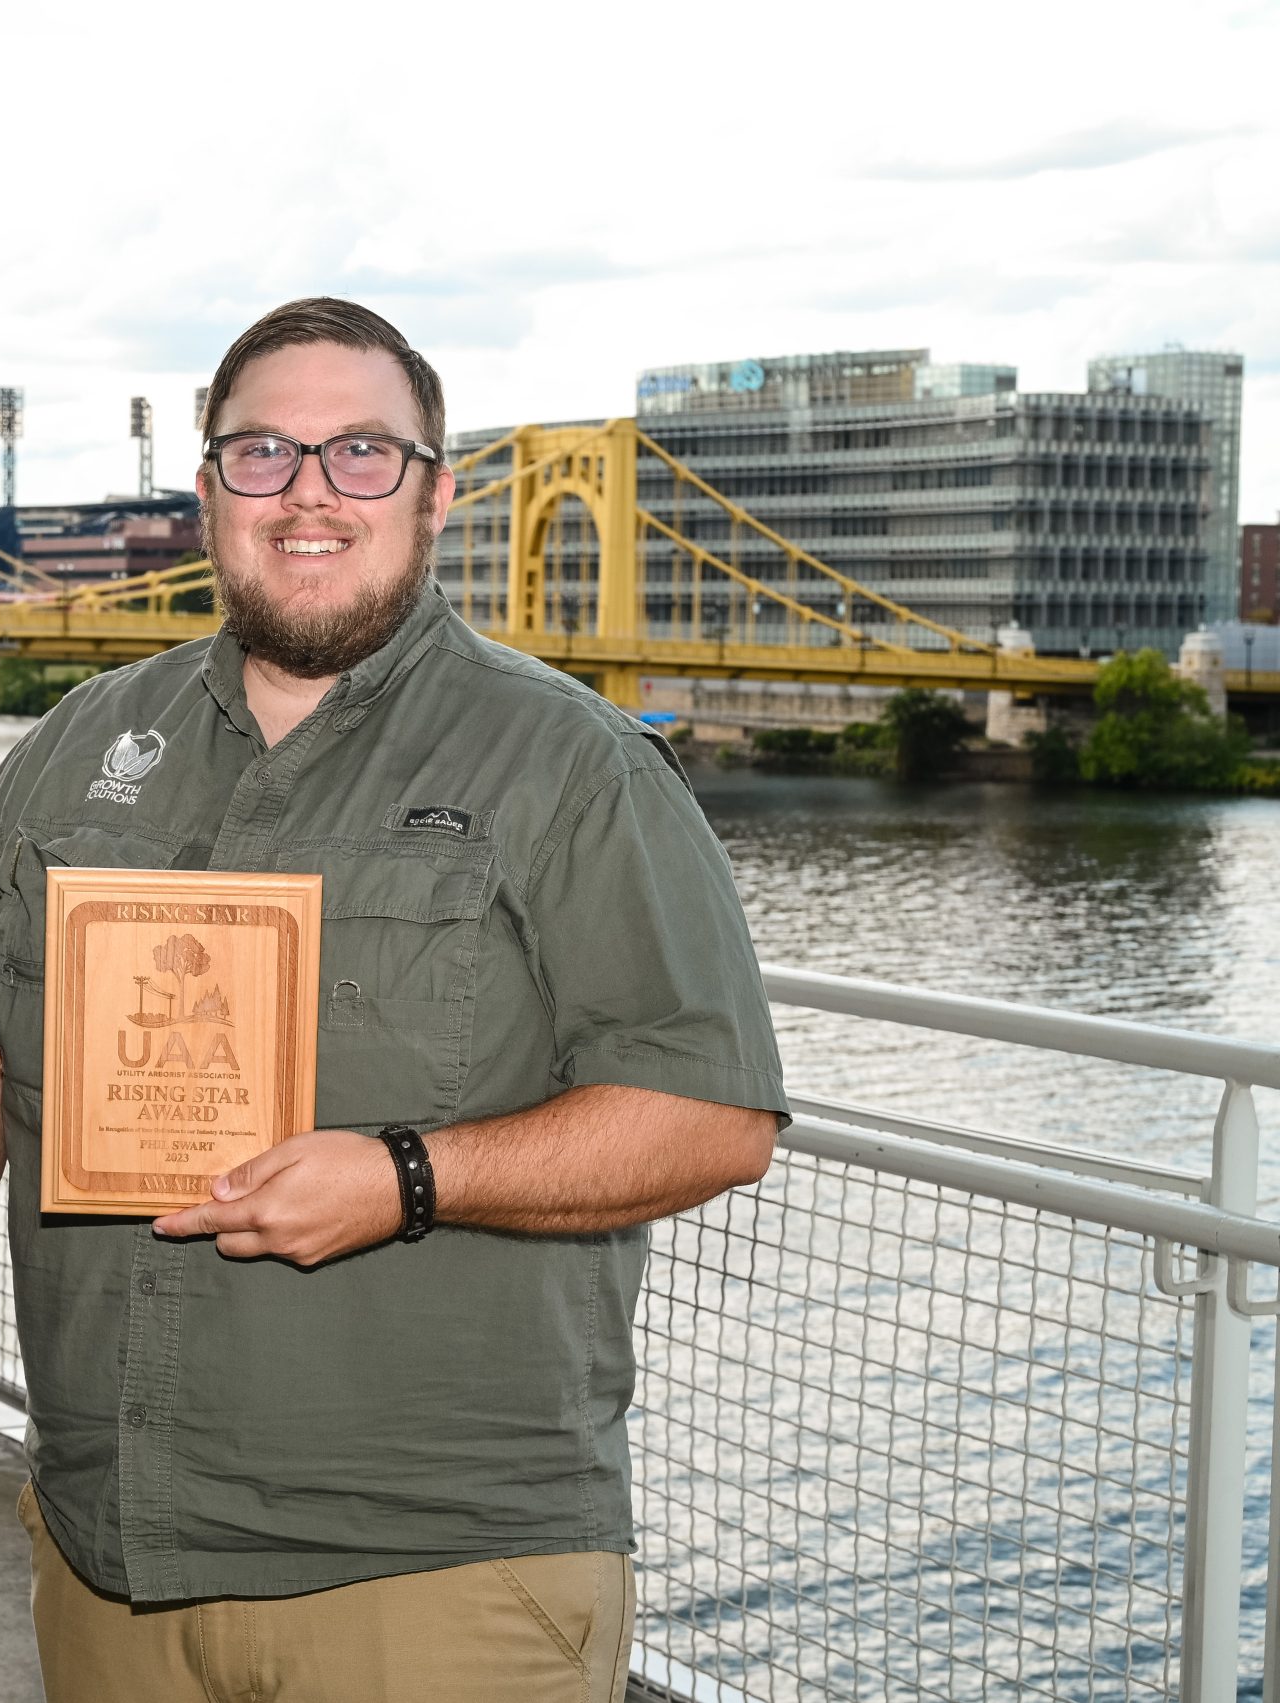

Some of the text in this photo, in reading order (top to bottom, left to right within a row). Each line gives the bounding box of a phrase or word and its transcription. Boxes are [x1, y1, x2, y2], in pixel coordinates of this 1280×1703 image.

[90, 780, 141, 794] GROWTH
[85, 789, 138, 805] OLUTIONS
[117, 904, 249, 923] RISING STAR
[117, 1030, 240, 1070] UAA
[148, 1071, 186, 1079] ARBORIST
[188, 1071, 241, 1080] ASSOCIATION
[107, 1084, 250, 1105] RISING STAR
[137, 1103, 219, 1122] AWARD
[225, 1129, 257, 1137] Organization
[140, 1140, 215, 1152] PHIL SWART
[165, 1152, 189, 1162] 2023
